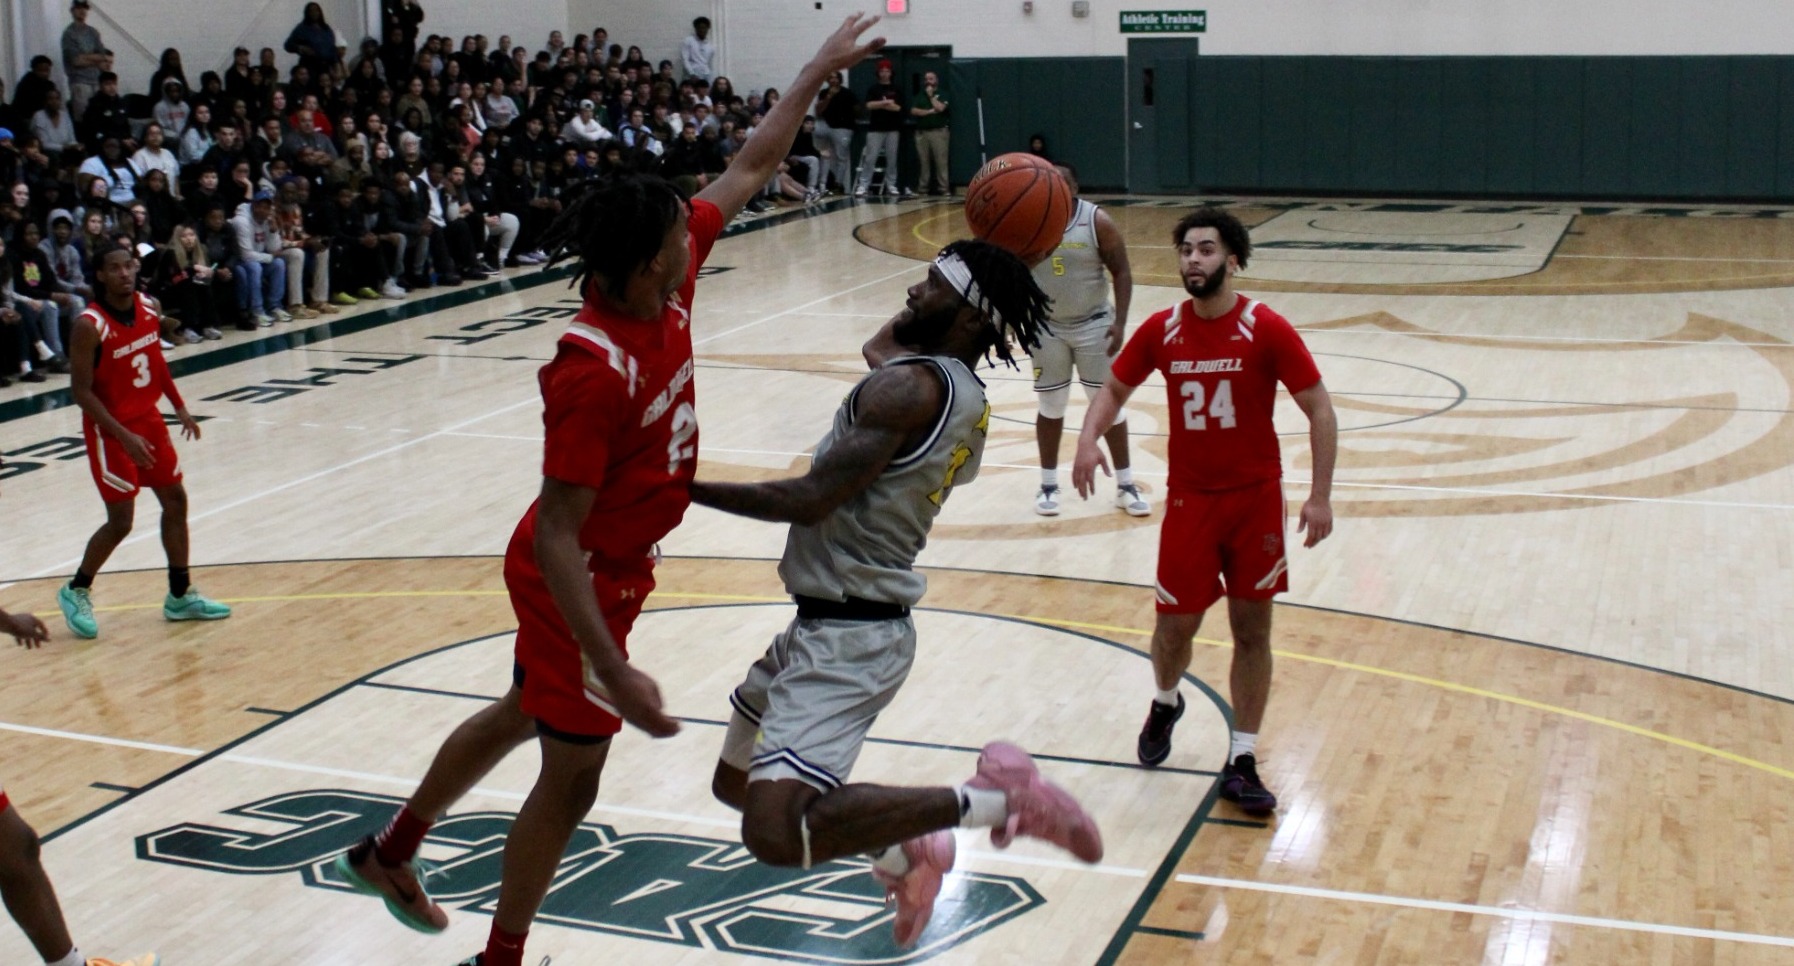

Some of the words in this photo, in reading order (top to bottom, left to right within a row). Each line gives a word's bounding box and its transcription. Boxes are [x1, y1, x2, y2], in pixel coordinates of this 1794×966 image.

[1122, 13, 1159, 24] Athletic
[1161, 13, 1204, 26] Training
[1052, 256, 1065, 275] 5
[131, 352, 152, 389] 3
[198, 353, 430, 404] THE
[1169, 358, 1243, 375] CALDWELL
[1180, 379, 1237, 431] 24
[667, 401, 698, 476] 2
